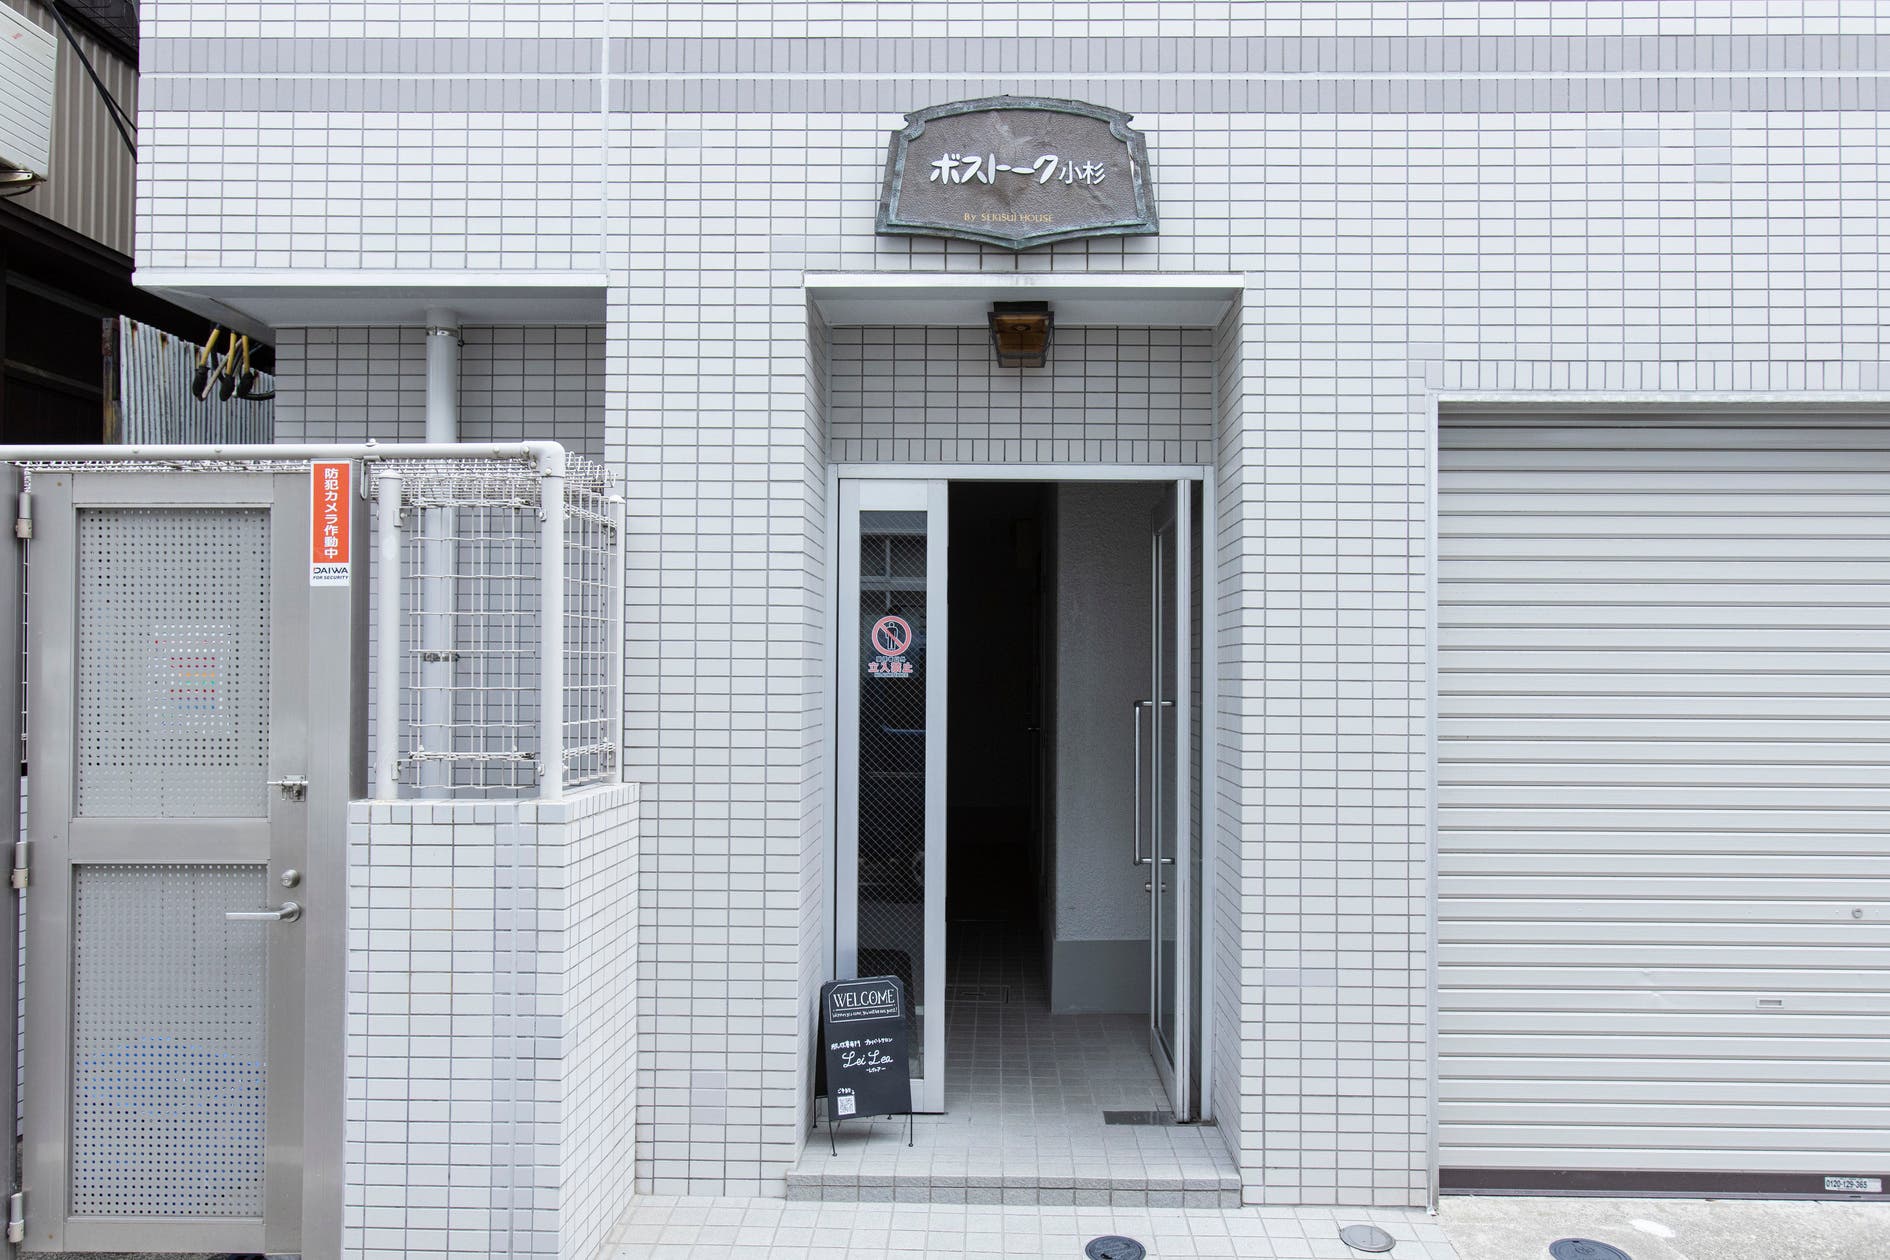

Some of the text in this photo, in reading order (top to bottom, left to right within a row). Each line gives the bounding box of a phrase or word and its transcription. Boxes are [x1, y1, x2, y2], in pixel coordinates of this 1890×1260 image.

[930, 153, 1106, 185] ボストーク小杉
[981, 212, 1017, 222] SEKISUI
[1019, 212, 1054, 223] HOUSE
[324, 467, 339, 559] 防犯カメラ作動中
[867, 661, 914, 673] 立入禁止
[833, 989, 895, 1008] WELCOME
[1826, 1179, 1868, 1189] 0120-129-365
